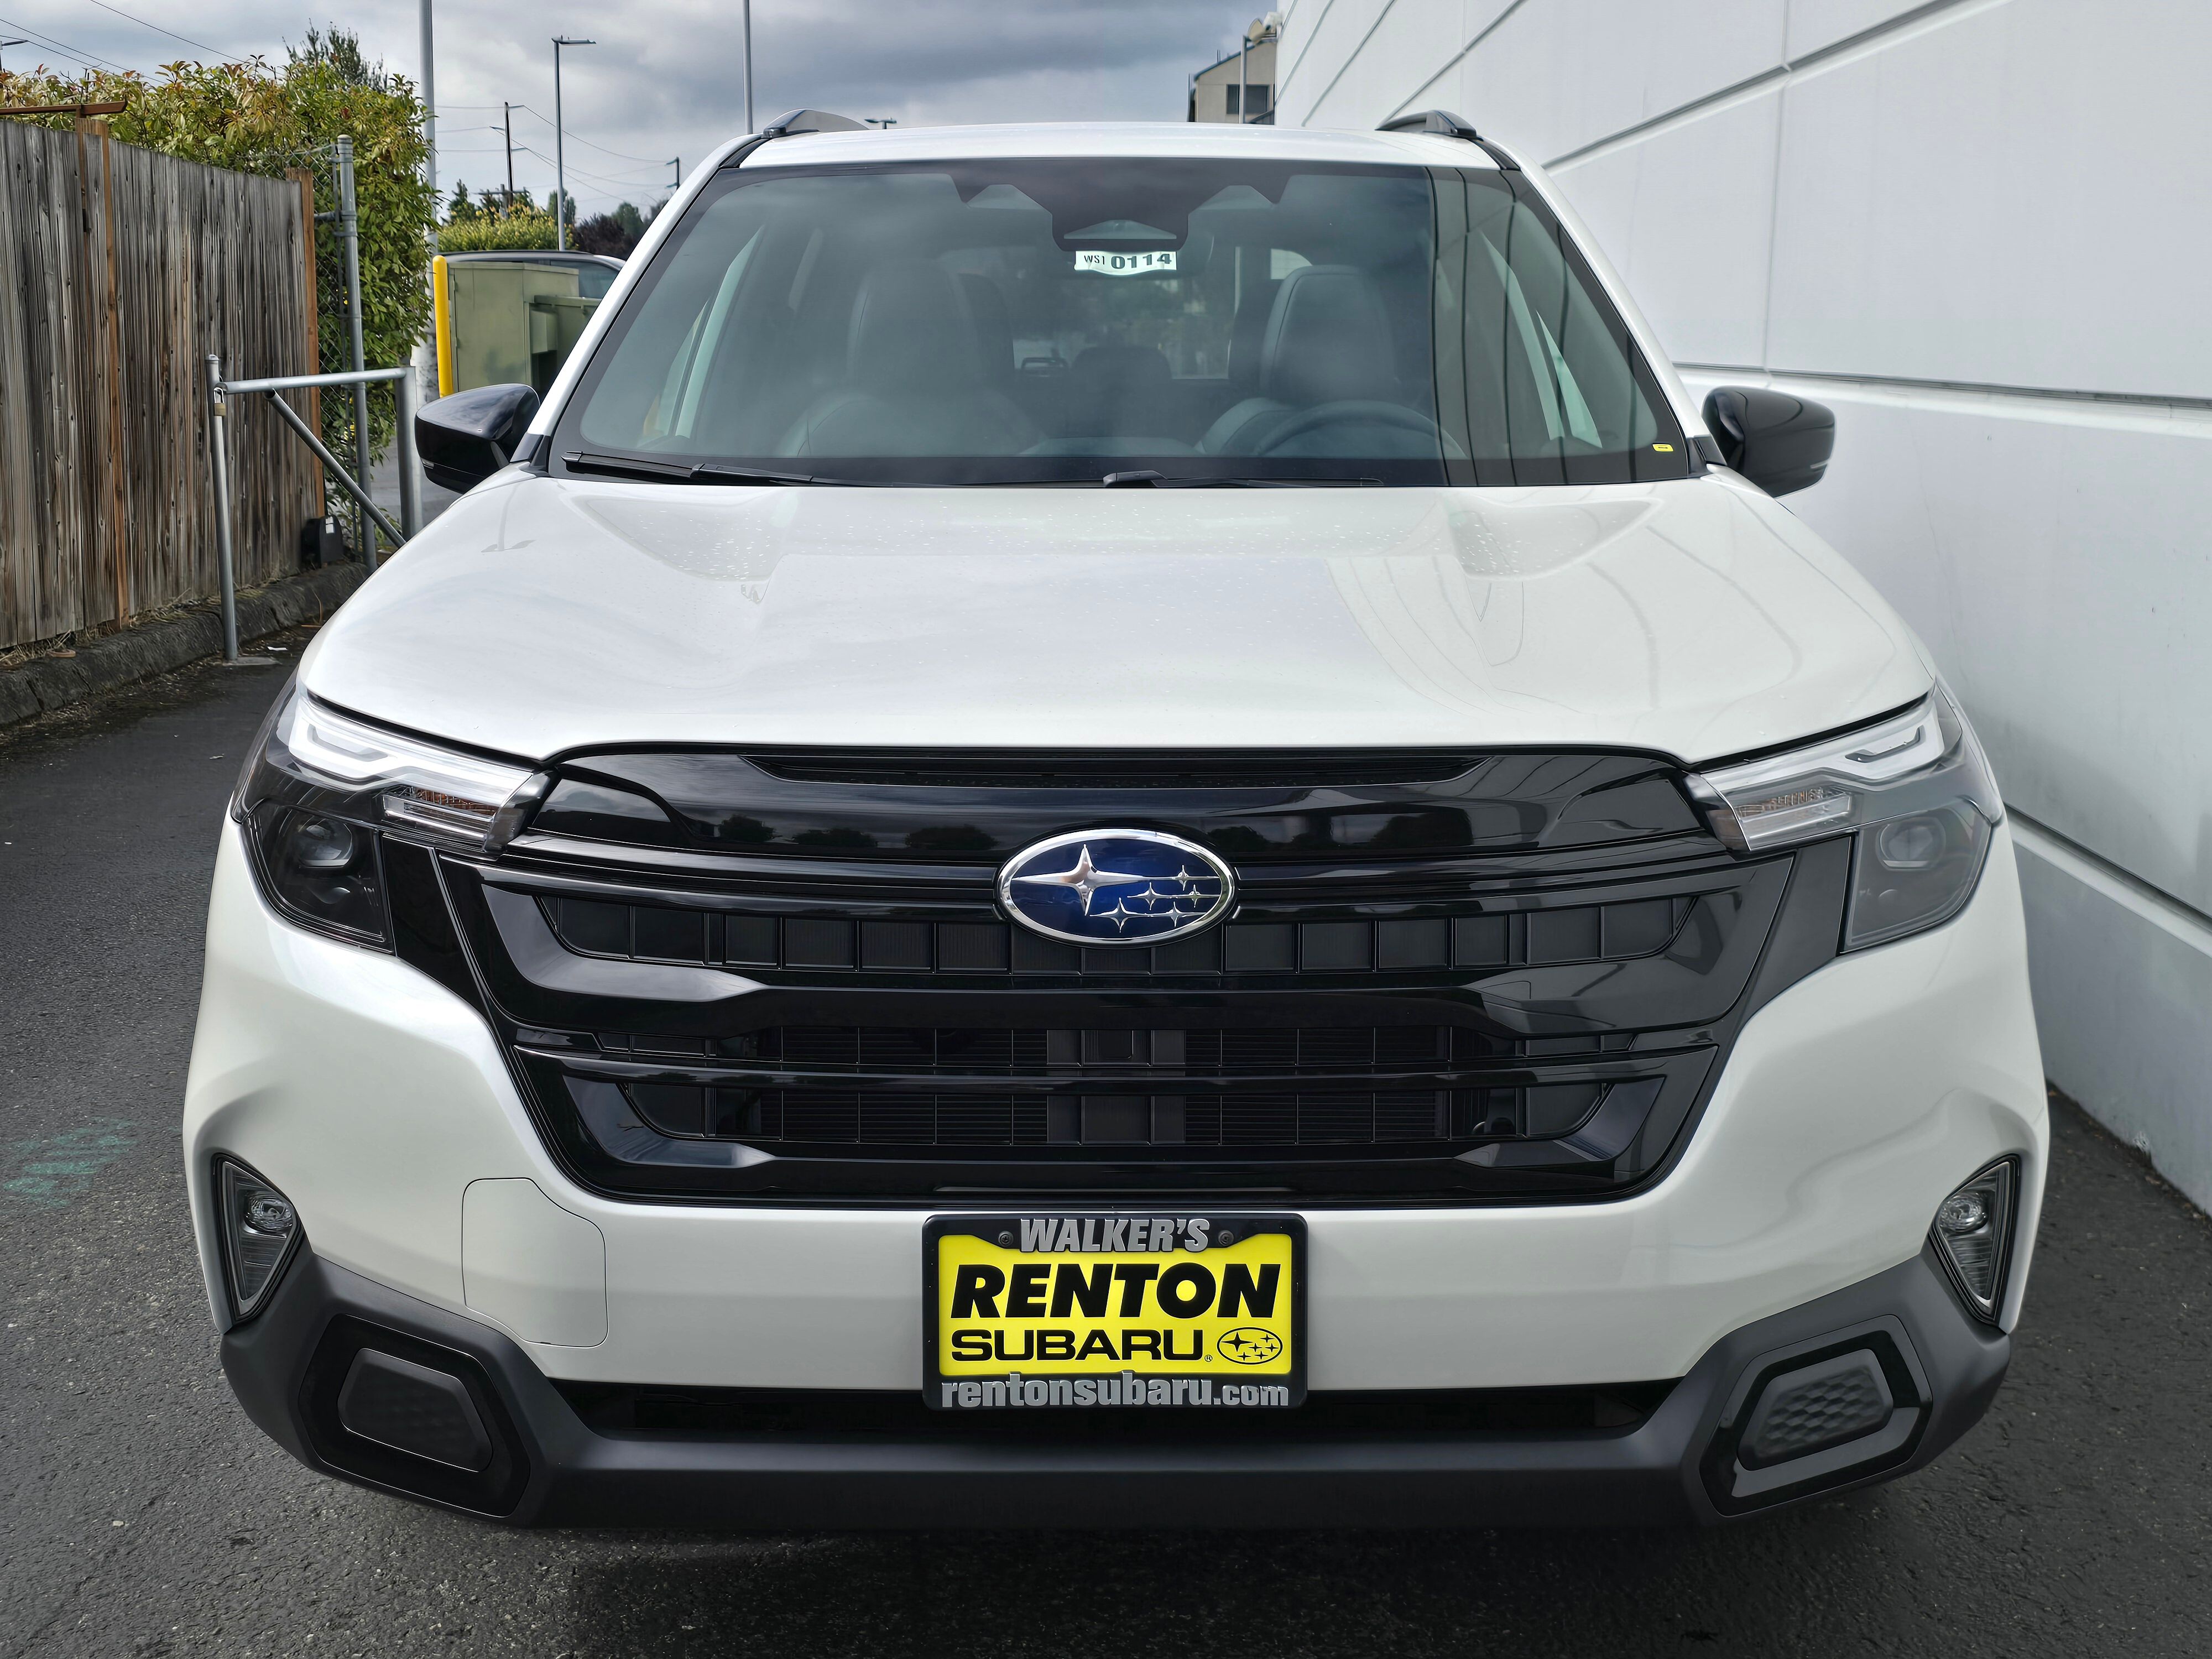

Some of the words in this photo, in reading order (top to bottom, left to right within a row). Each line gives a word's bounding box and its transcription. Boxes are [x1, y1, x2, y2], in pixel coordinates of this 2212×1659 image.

[1111, 253, 1172, 269] 0114
[1020, 1218, 1210, 1253] WALKER'S
[950, 1262, 1281, 1319] RENTON
[941, 1371, 1289, 1408] rentonsubaru.com
